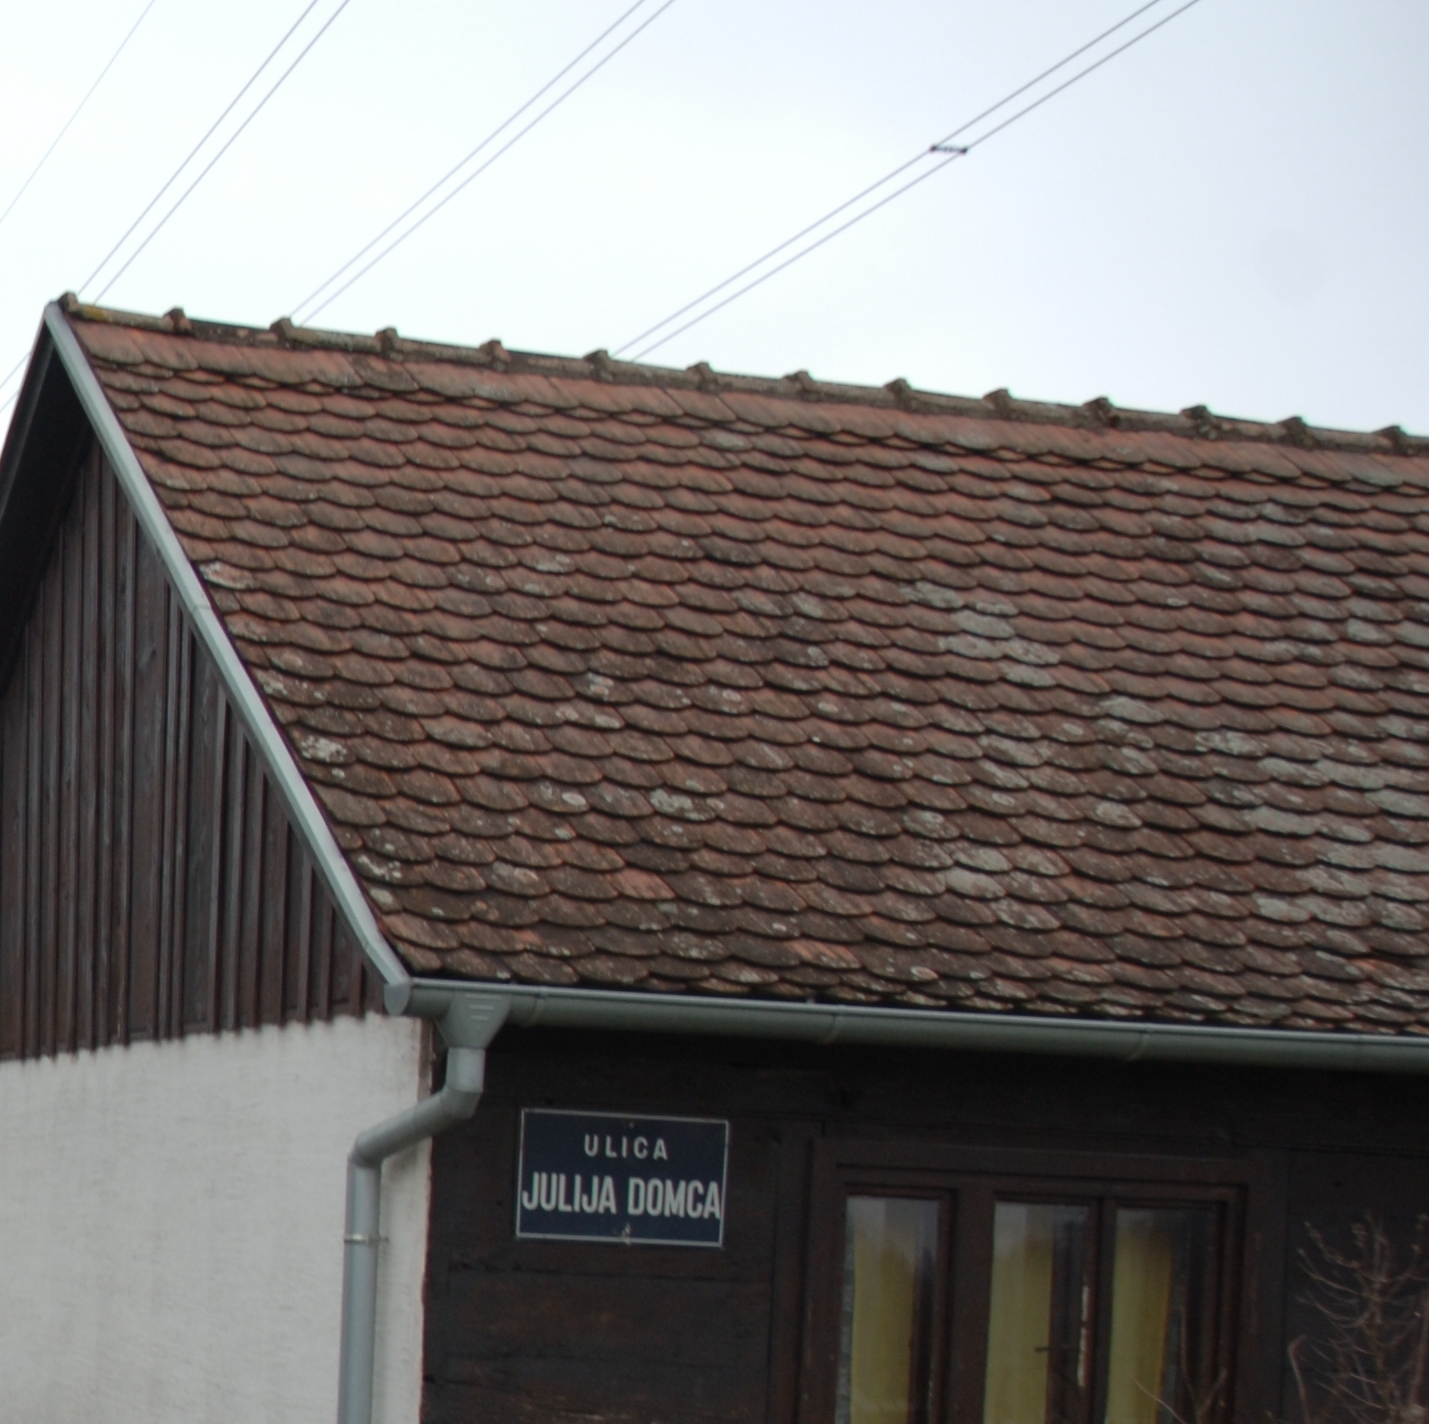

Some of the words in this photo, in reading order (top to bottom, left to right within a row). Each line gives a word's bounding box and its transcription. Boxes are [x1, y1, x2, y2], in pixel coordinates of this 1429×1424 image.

[584, 1134, 668, 1160] ULICA
[522, 1172, 617, 1214] JULIJA
[627, 1177, 720, 1219] DOMCA
